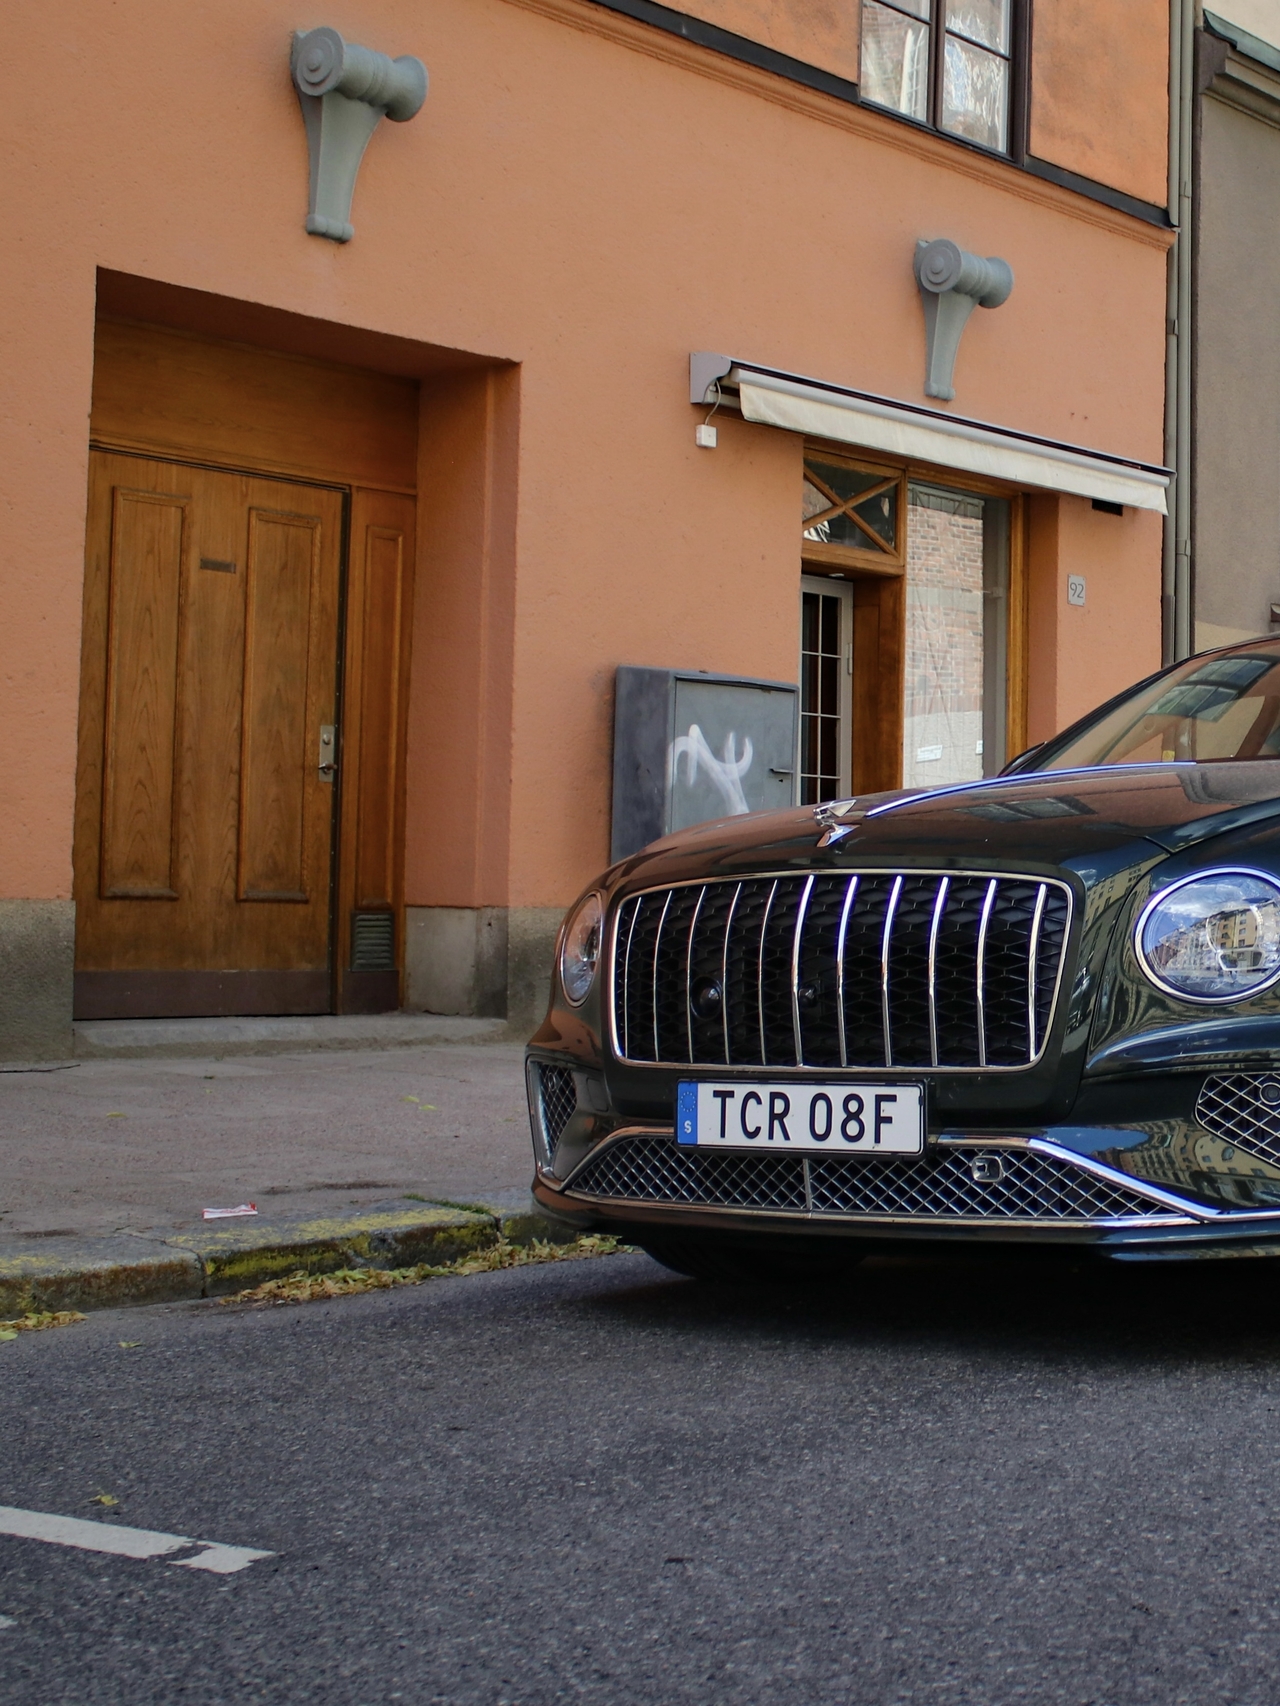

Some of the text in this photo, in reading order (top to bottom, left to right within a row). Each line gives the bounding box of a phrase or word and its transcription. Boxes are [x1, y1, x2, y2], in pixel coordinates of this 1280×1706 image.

[1070, 582, 1084, 599] 92
[713, 1090, 897, 1144] TCR 08F
[684, 1120, 692, 1134] S
